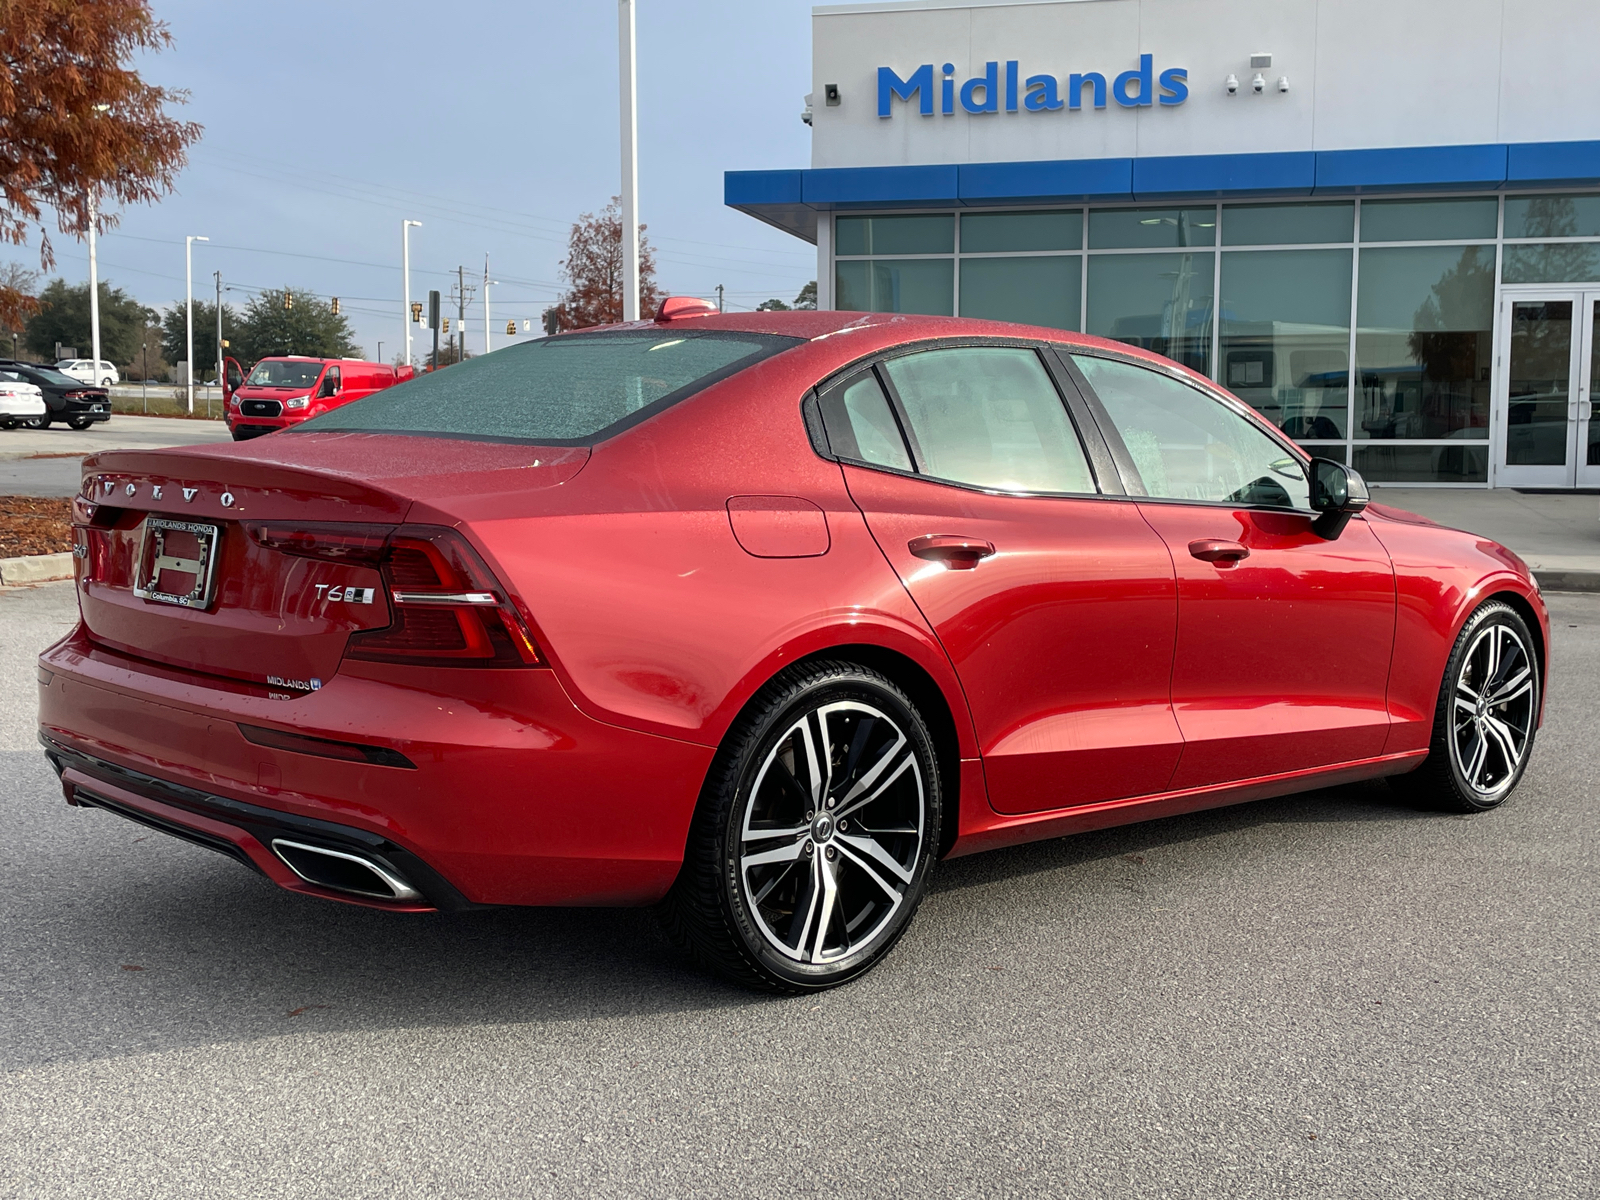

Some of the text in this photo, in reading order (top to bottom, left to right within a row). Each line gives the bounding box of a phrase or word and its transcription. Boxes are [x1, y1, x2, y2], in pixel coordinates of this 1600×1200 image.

[877, 53, 1189, 118] Midlands
[104, 481, 235, 508] VOLVO
[153, 520, 213, 533] MIDLANDS HONDA
[315, 584, 343, 602] T6
[267, 675, 310, 690] MIDLANDS
[729, 862, 751, 936] MICHELIN
